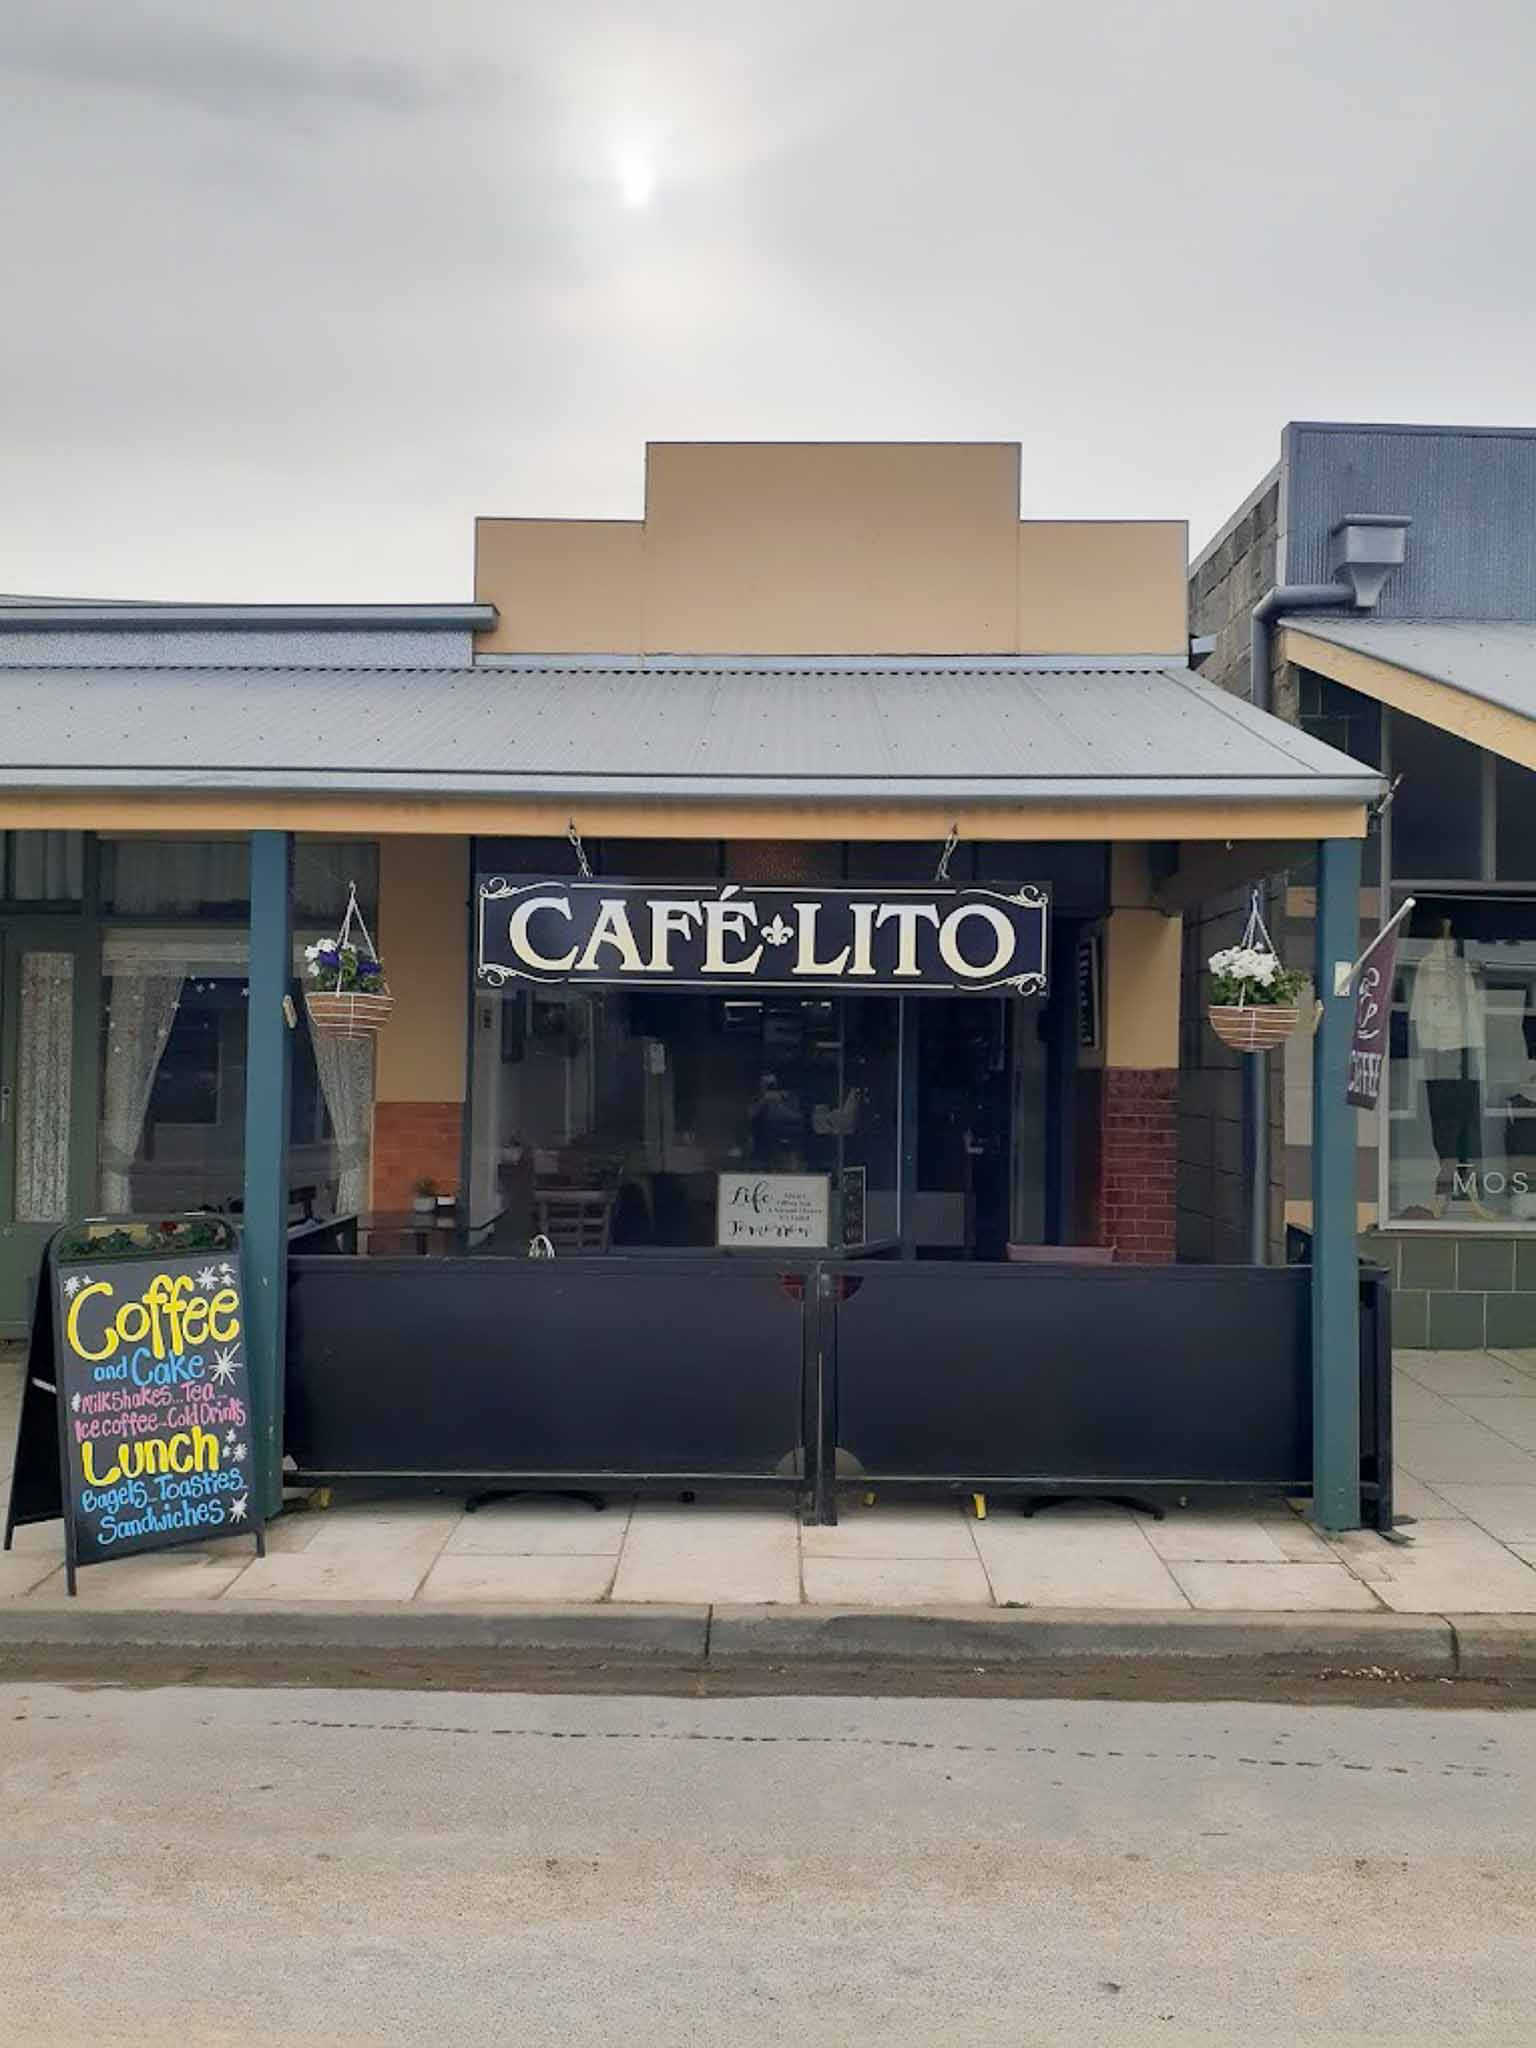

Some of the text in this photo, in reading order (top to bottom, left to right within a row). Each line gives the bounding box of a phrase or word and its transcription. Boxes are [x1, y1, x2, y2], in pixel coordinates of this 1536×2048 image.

[508, 885, 1017, 977] CAFÉ LITO
[67, 1274, 240, 1361] Coffee
[94, 1347, 205, 1386] and Cake
[168, 1403, 200, 1428] Cold
[200, 1397, 246, 1427] Drinks
[81, 1425, 220, 1487] Lunch
[98, 1499, 226, 1545] Sandwiches
